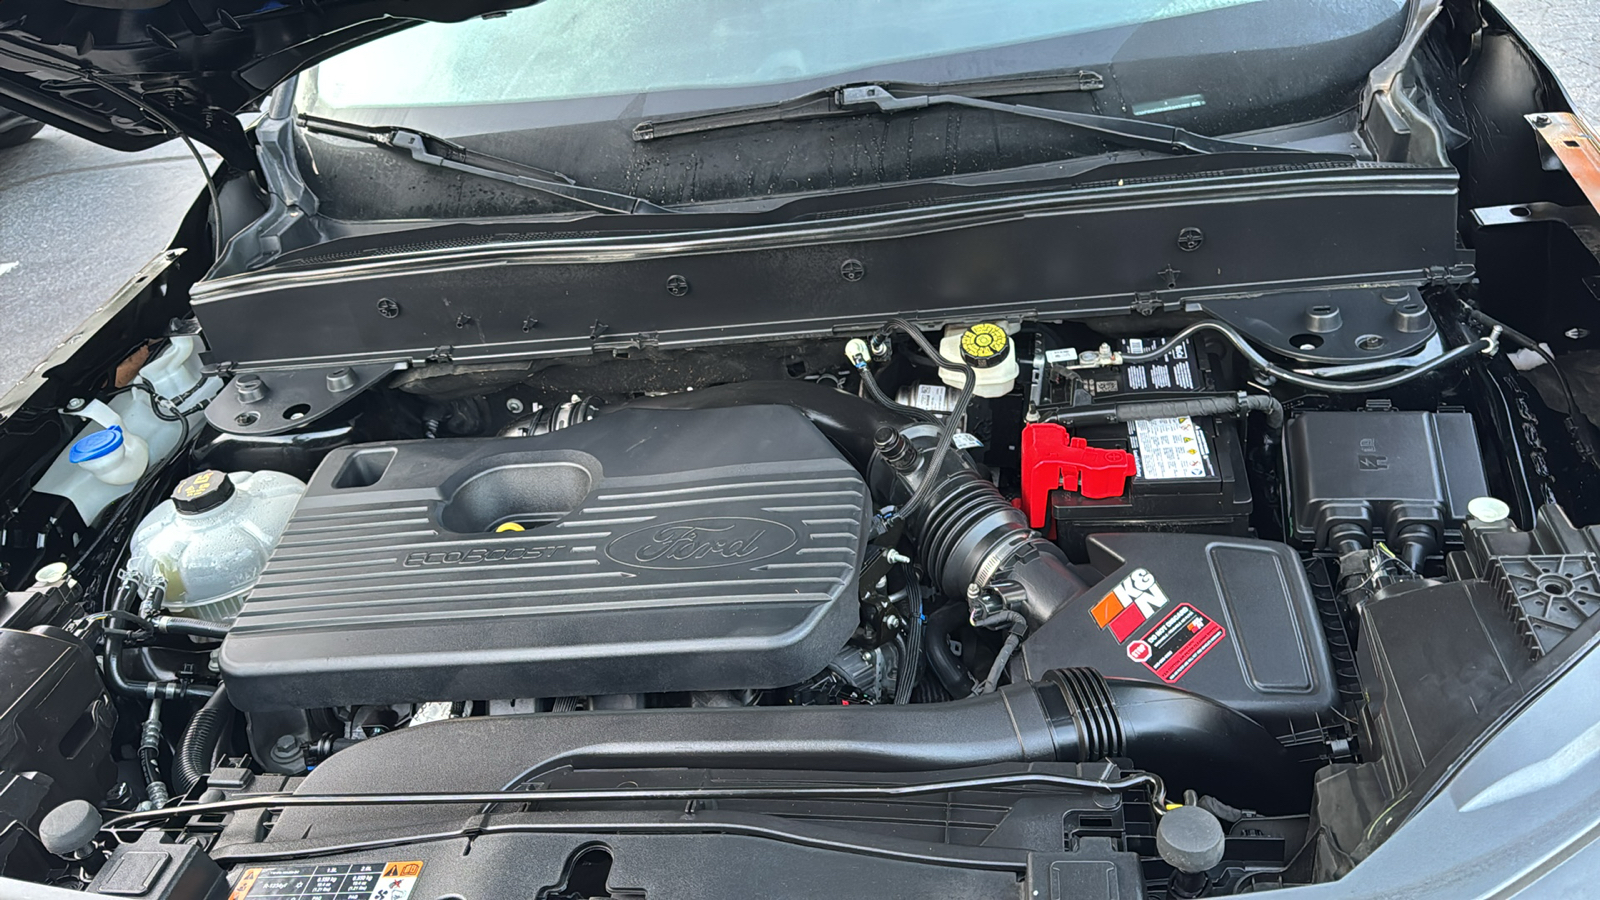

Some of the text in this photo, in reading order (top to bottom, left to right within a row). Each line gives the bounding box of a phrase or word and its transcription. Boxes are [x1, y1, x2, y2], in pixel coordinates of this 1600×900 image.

[634, 523, 764, 562] Ford
[1113, 567, 1168, 620] K&N
[1131, 644, 1146, 658] STOP
